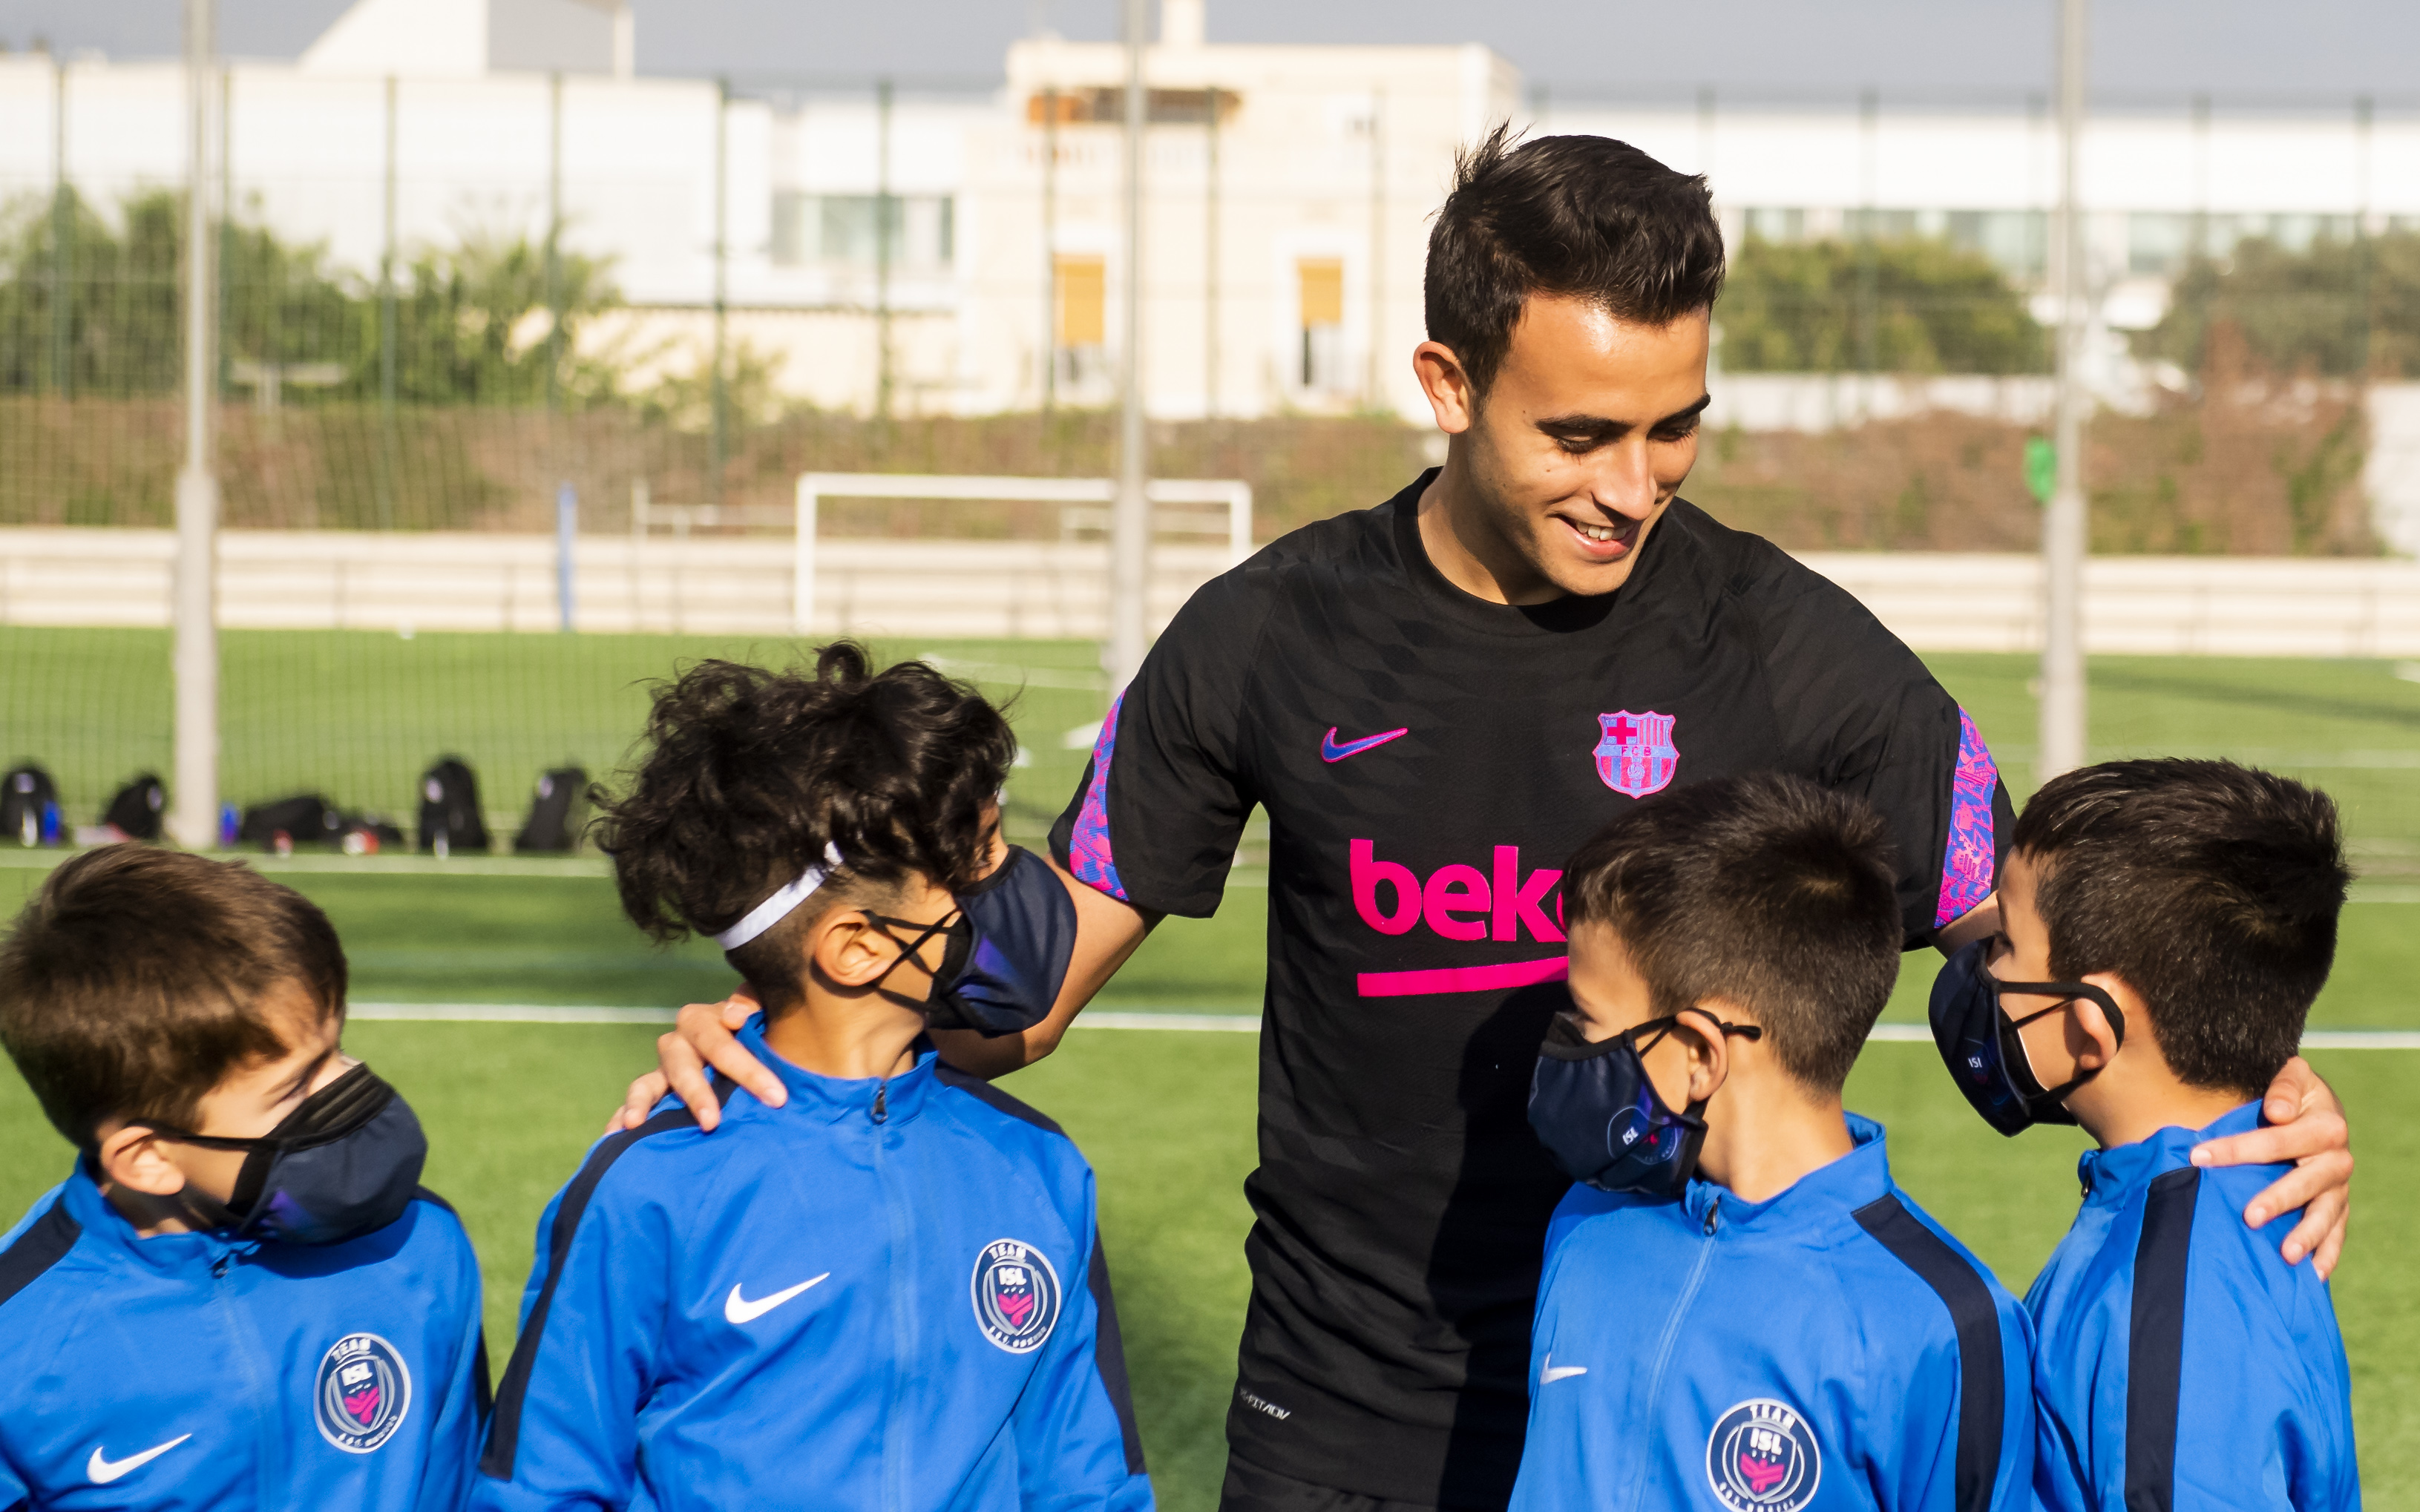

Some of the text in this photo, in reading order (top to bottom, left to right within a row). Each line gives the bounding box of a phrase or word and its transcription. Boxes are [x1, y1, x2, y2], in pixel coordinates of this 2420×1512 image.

[1350, 838, 1569, 943] bek
[1622, 1126, 1639, 1145] ISL
[988, 1243, 1027, 1260] TEAM
[998, 1267, 1027, 1286] ISL
[1750, 1427, 1783, 1456] ISL
